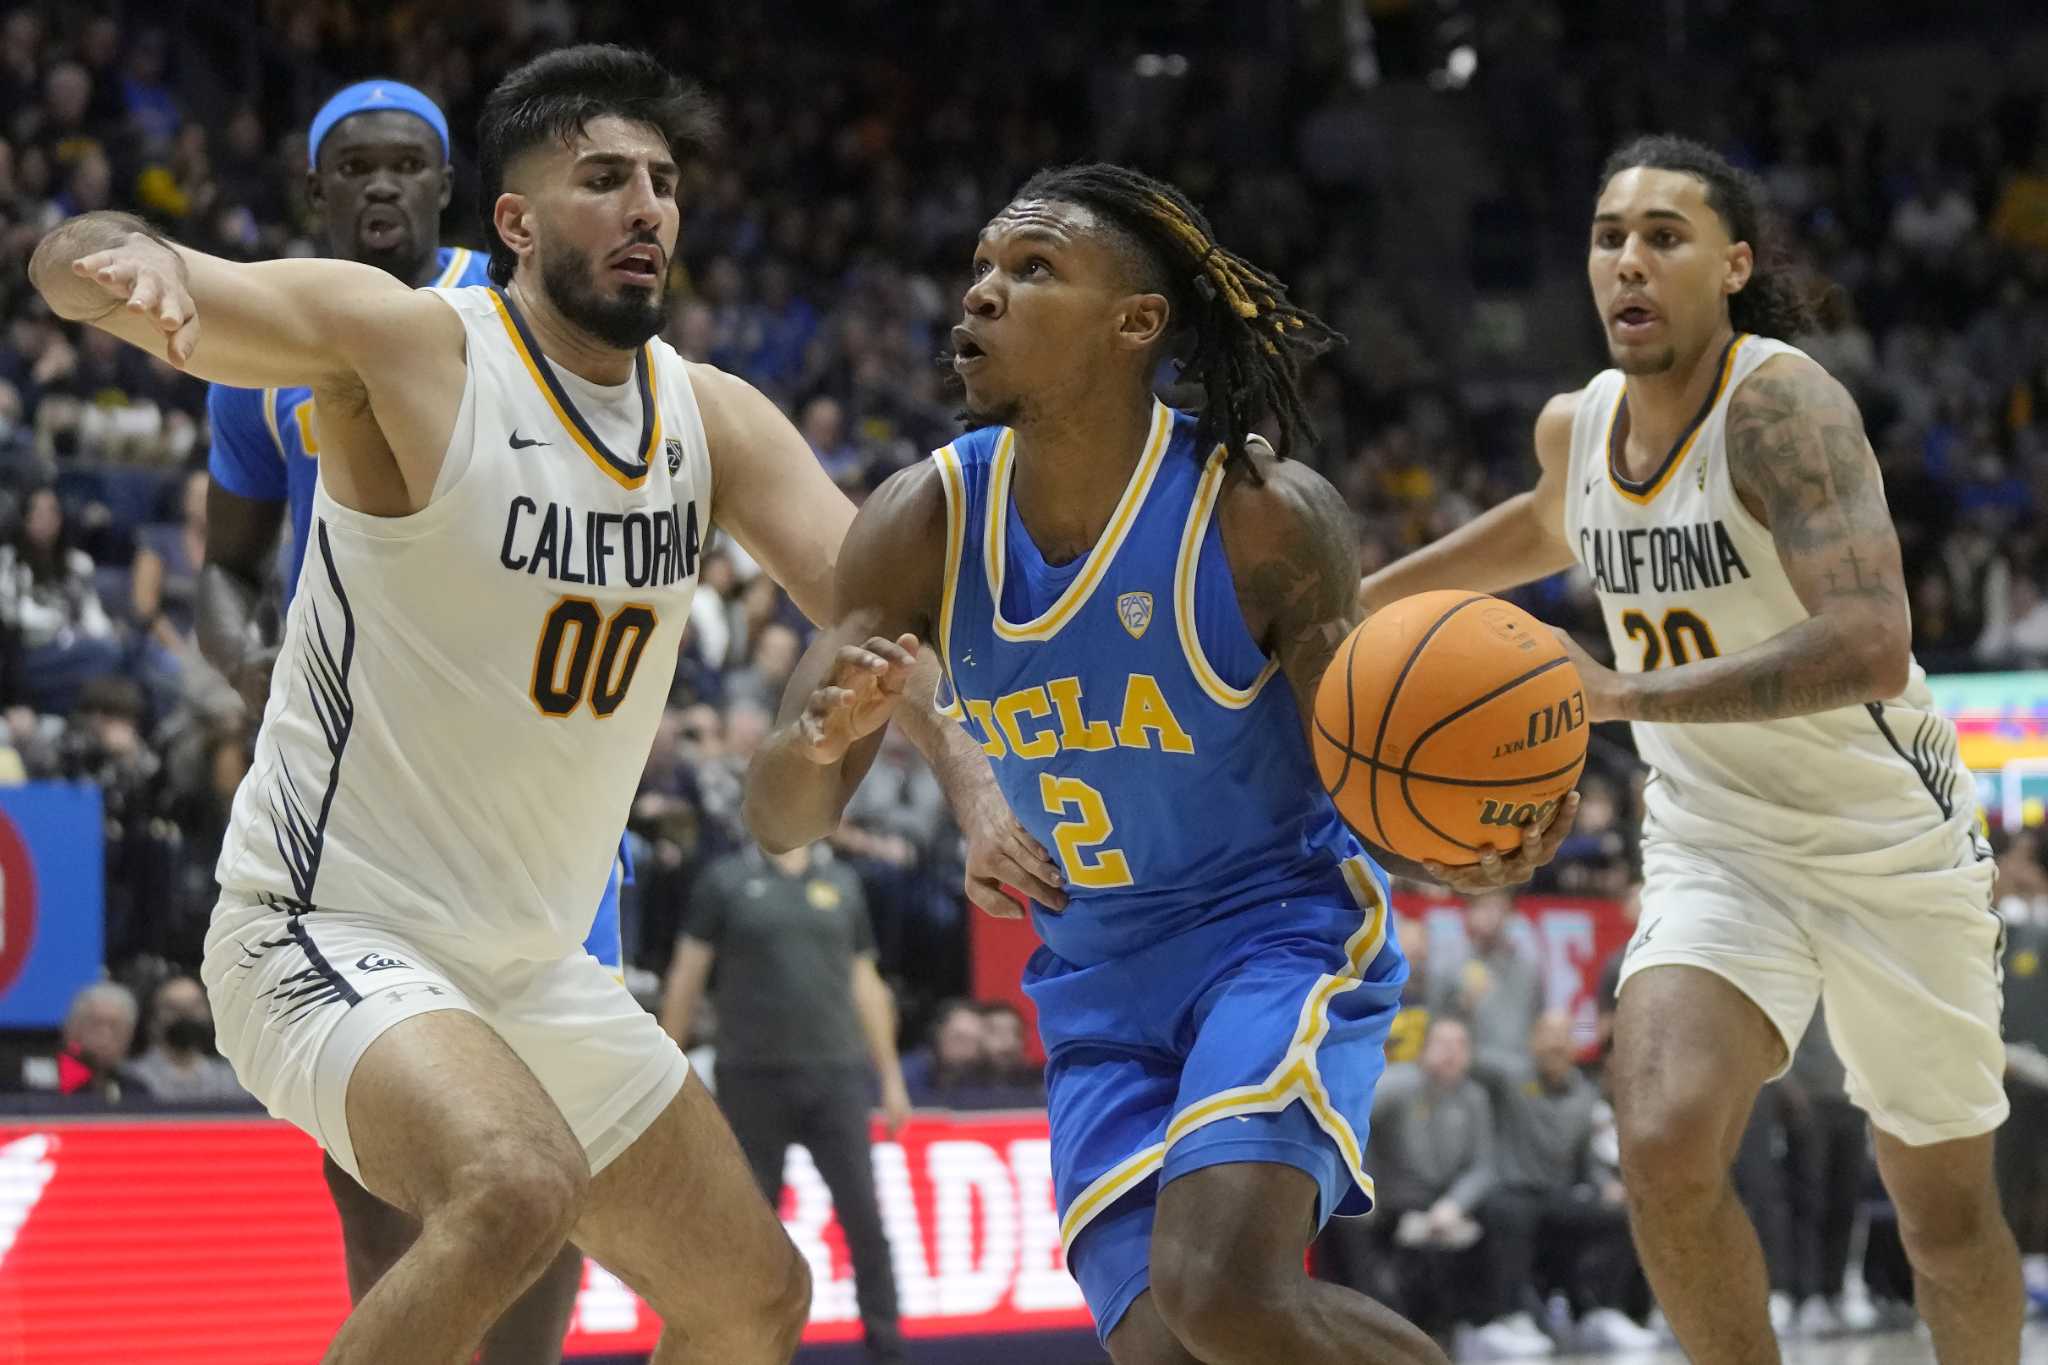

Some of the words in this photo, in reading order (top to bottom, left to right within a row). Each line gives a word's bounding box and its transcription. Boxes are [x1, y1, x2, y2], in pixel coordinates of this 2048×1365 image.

[1580, 520, 1751, 594] CALIFORNIA
[529, 594, 659, 720] 00
[1527, 689, 1585, 748] EVO
[1039, 772, 1134, 889] 2
